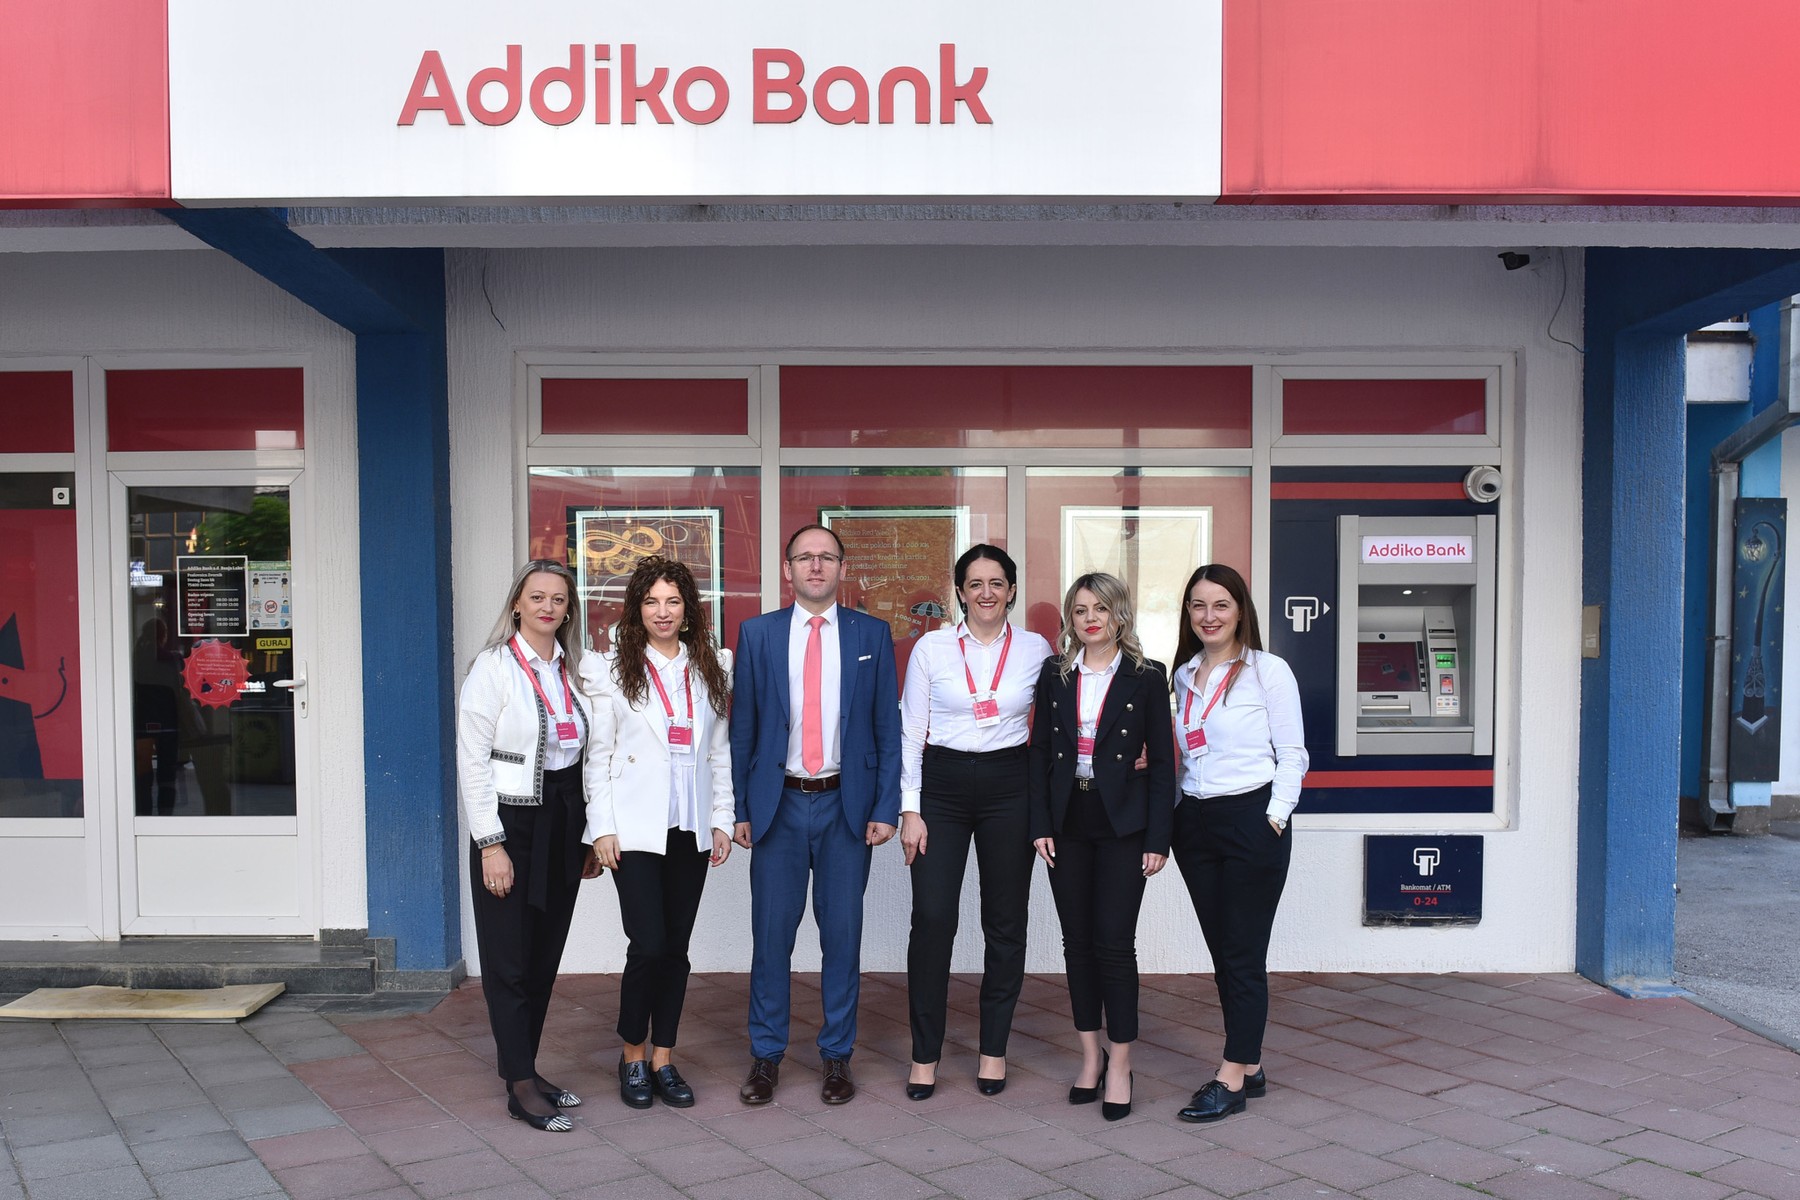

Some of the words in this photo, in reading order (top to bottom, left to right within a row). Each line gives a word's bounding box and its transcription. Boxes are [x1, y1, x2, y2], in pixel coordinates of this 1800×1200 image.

[397, 44, 730, 125] Addiko
[752, 43, 994, 124] Bank
[1368, 543, 1423, 556] Addiko
[1426, 543, 1466, 556] Bank
[1413, 896, 1438, 906] 0-24
